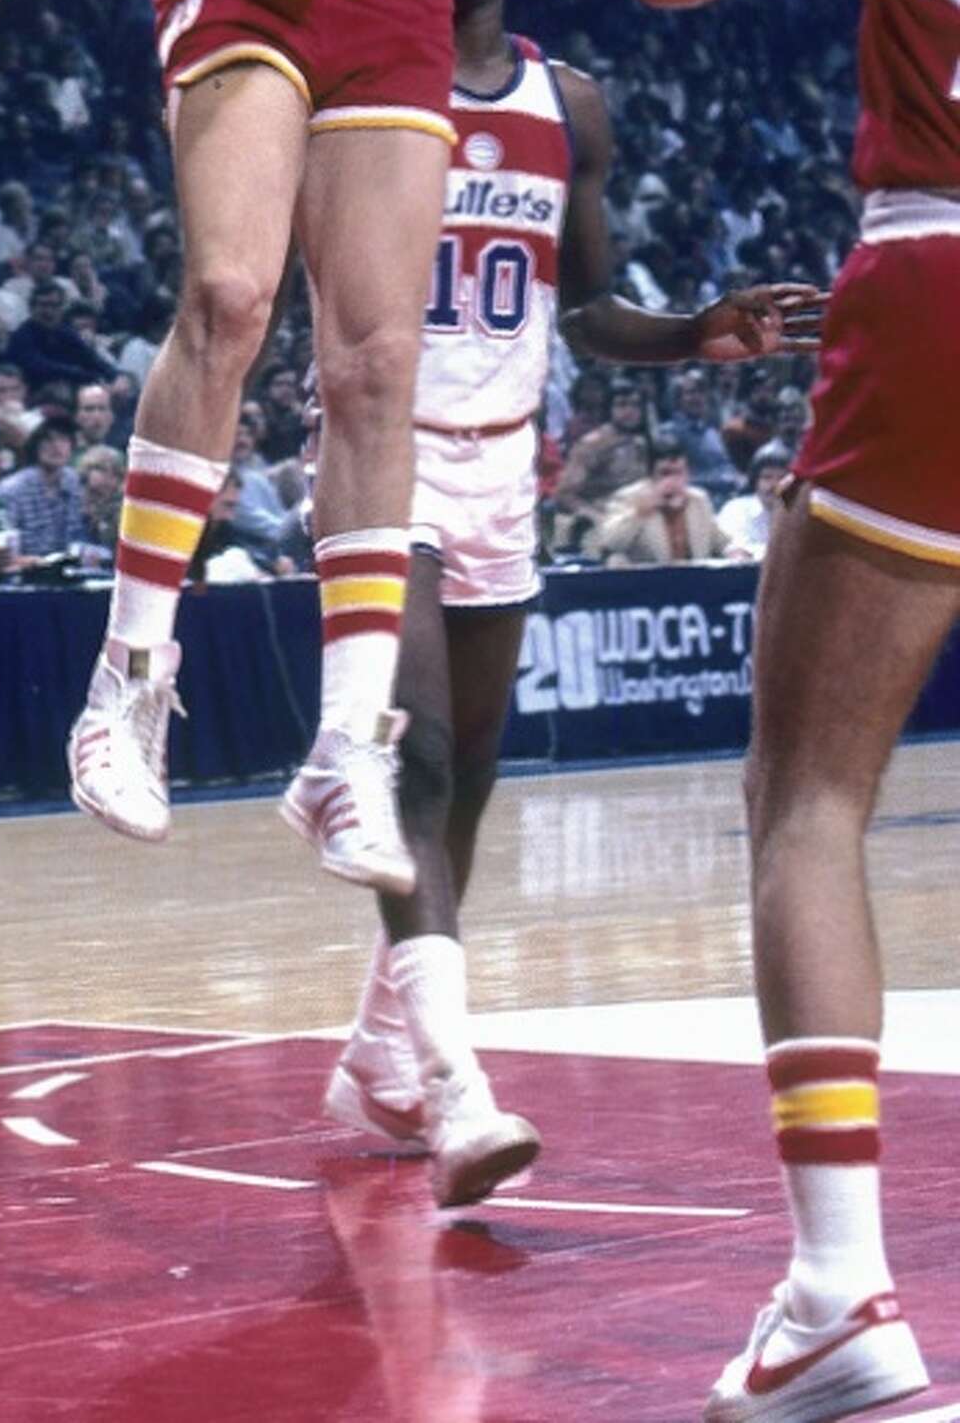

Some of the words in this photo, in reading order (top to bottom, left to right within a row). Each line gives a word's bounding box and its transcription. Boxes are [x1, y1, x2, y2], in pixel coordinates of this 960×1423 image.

[443, 180, 553, 223] ullets
[423, 234, 536, 338] 10
[515, 612, 598, 713] 20
[595, 603, 752, 662] WDCA-T
[596, 662, 737, 716] Washington
